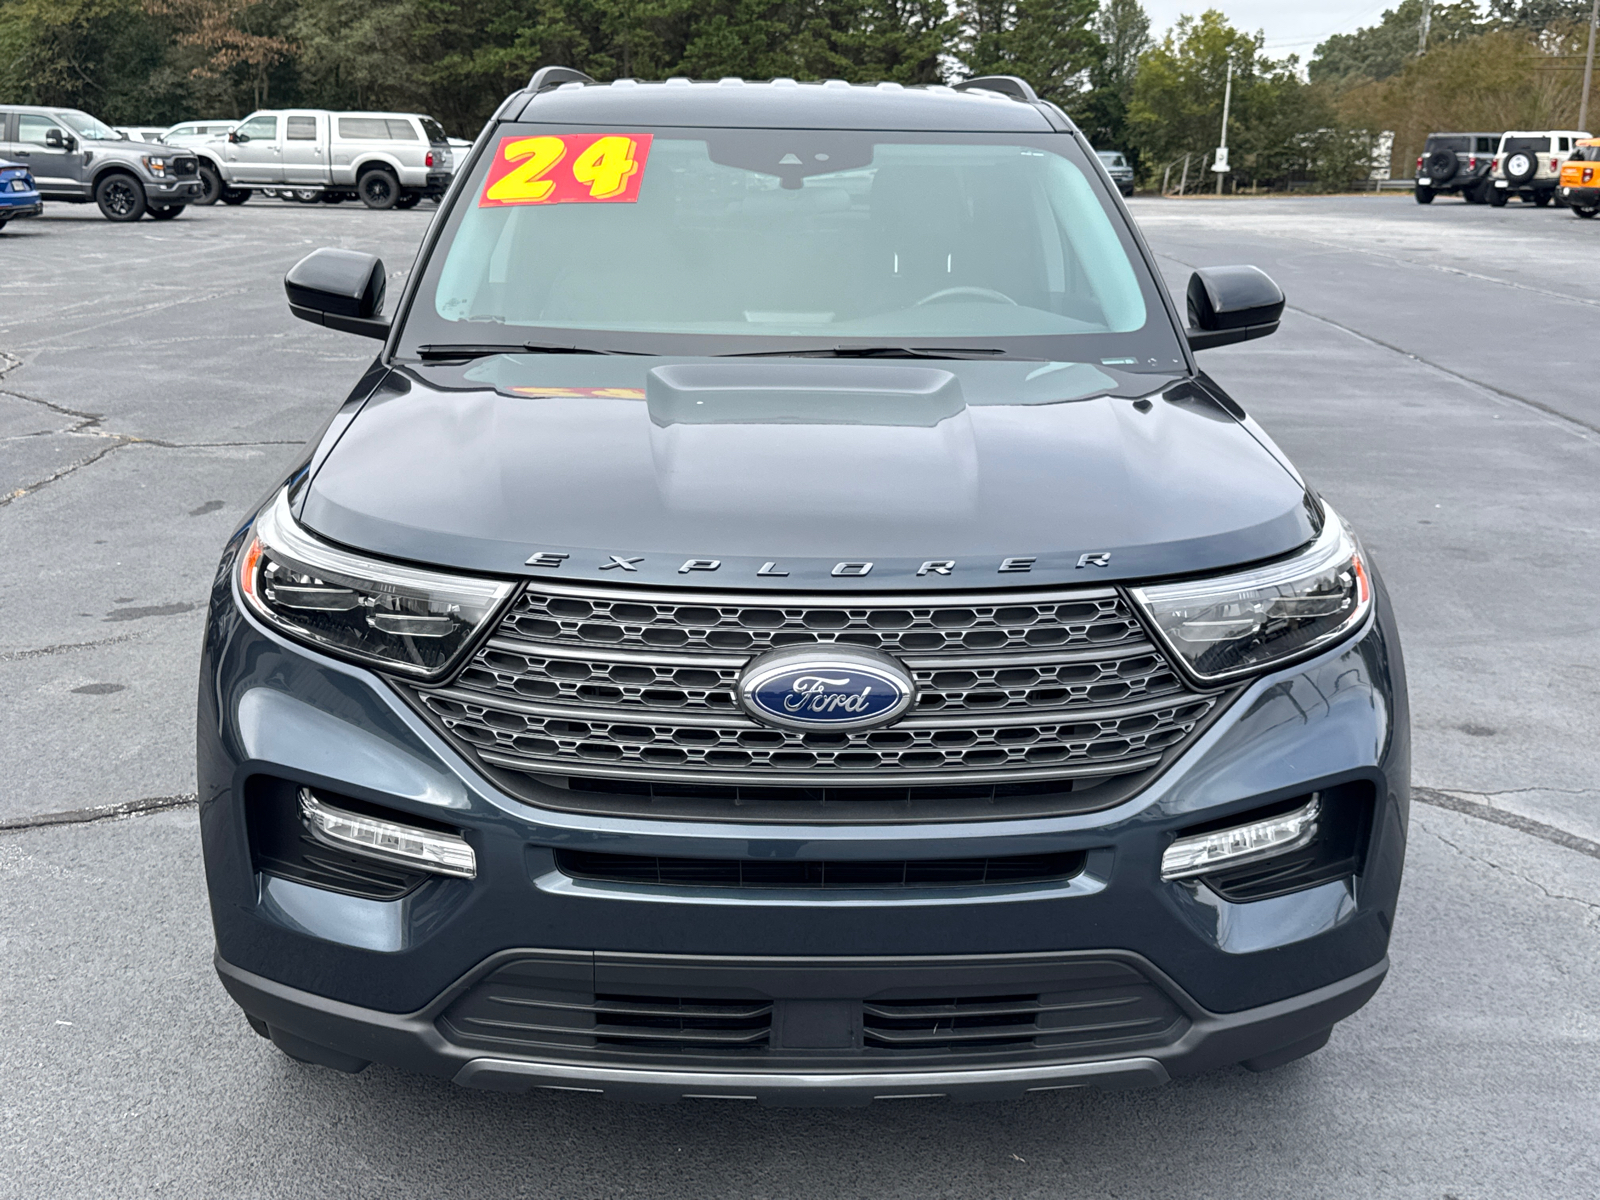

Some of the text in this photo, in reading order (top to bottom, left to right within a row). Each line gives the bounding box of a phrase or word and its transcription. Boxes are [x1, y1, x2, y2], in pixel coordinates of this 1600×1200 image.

[486, 136, 639, 203] 24
[524, 551, 1111, 577] EXPLORER
[783, 676, 871, 712] Ford
